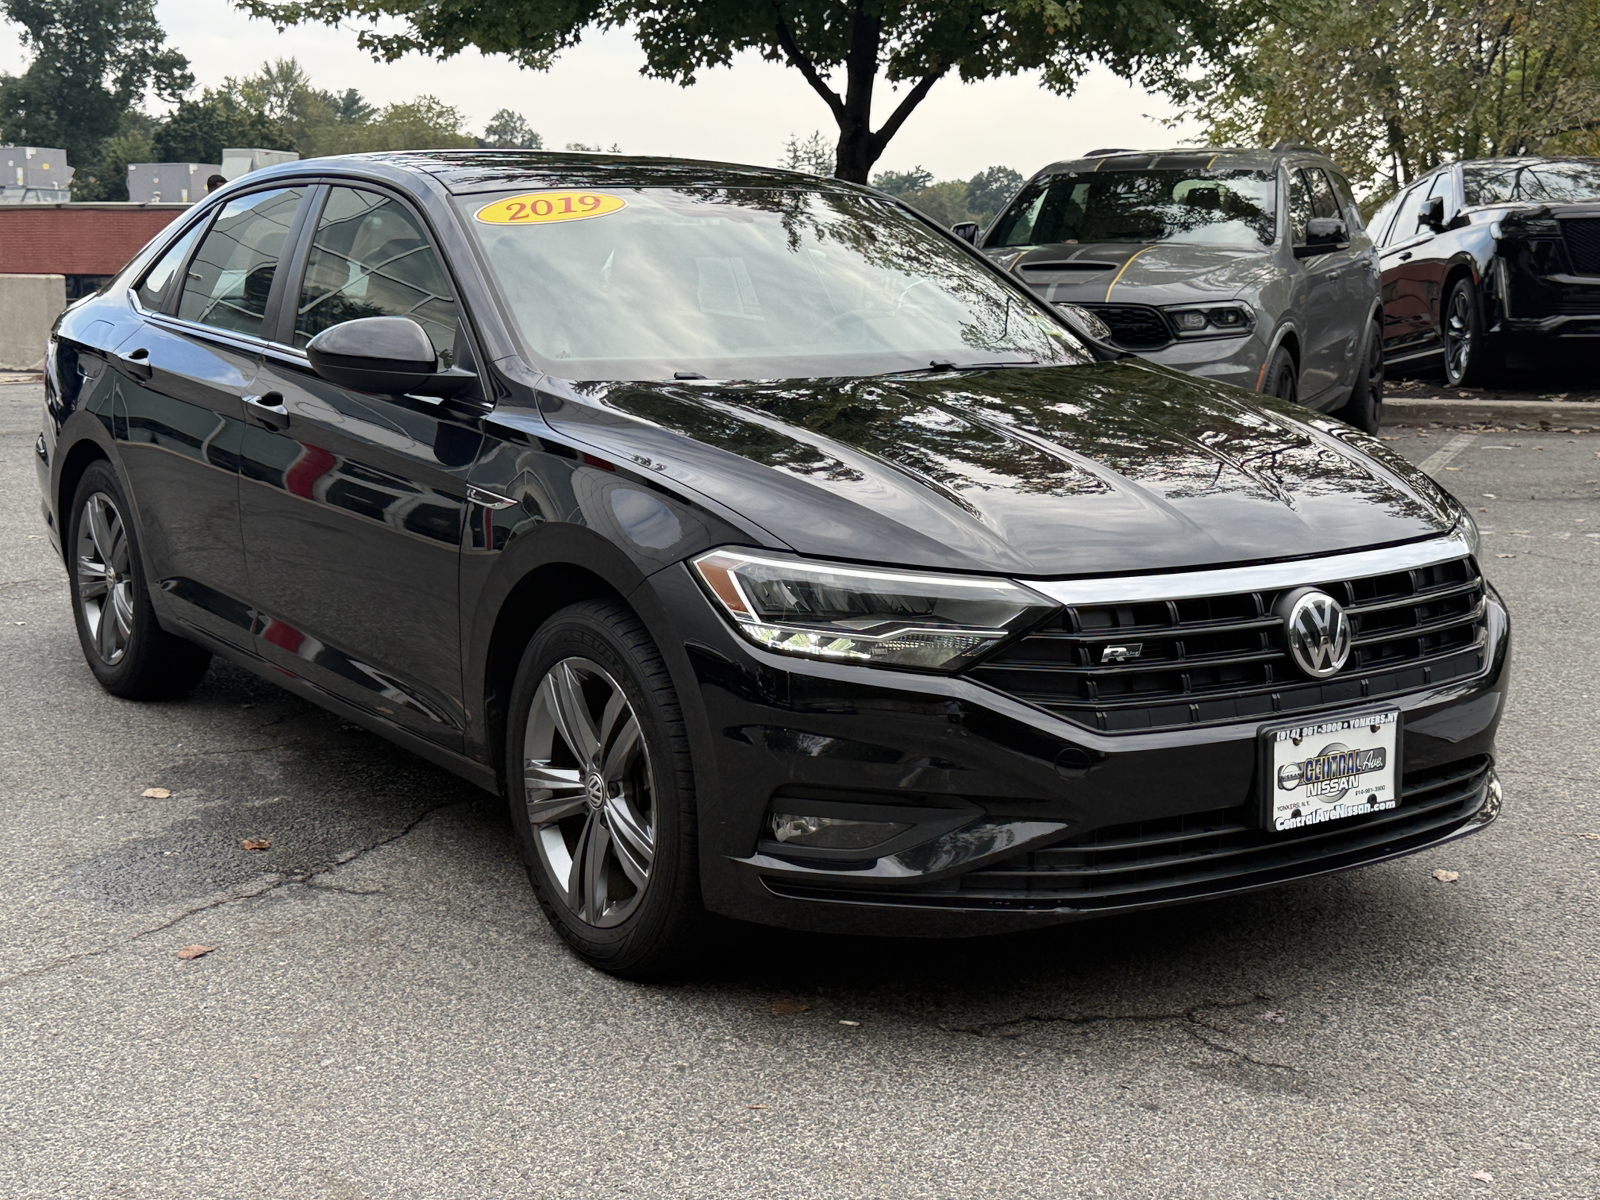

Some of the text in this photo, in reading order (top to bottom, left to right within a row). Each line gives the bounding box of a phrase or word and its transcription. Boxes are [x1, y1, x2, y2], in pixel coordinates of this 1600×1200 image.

[505, 195, 602, 221] 2019
[1304, 749, 1361, 784] CENTRAL
[1305, 775, 1360, 798] NISSAN
[1275, 800, 1396, 831] CentralAveNissan.com
